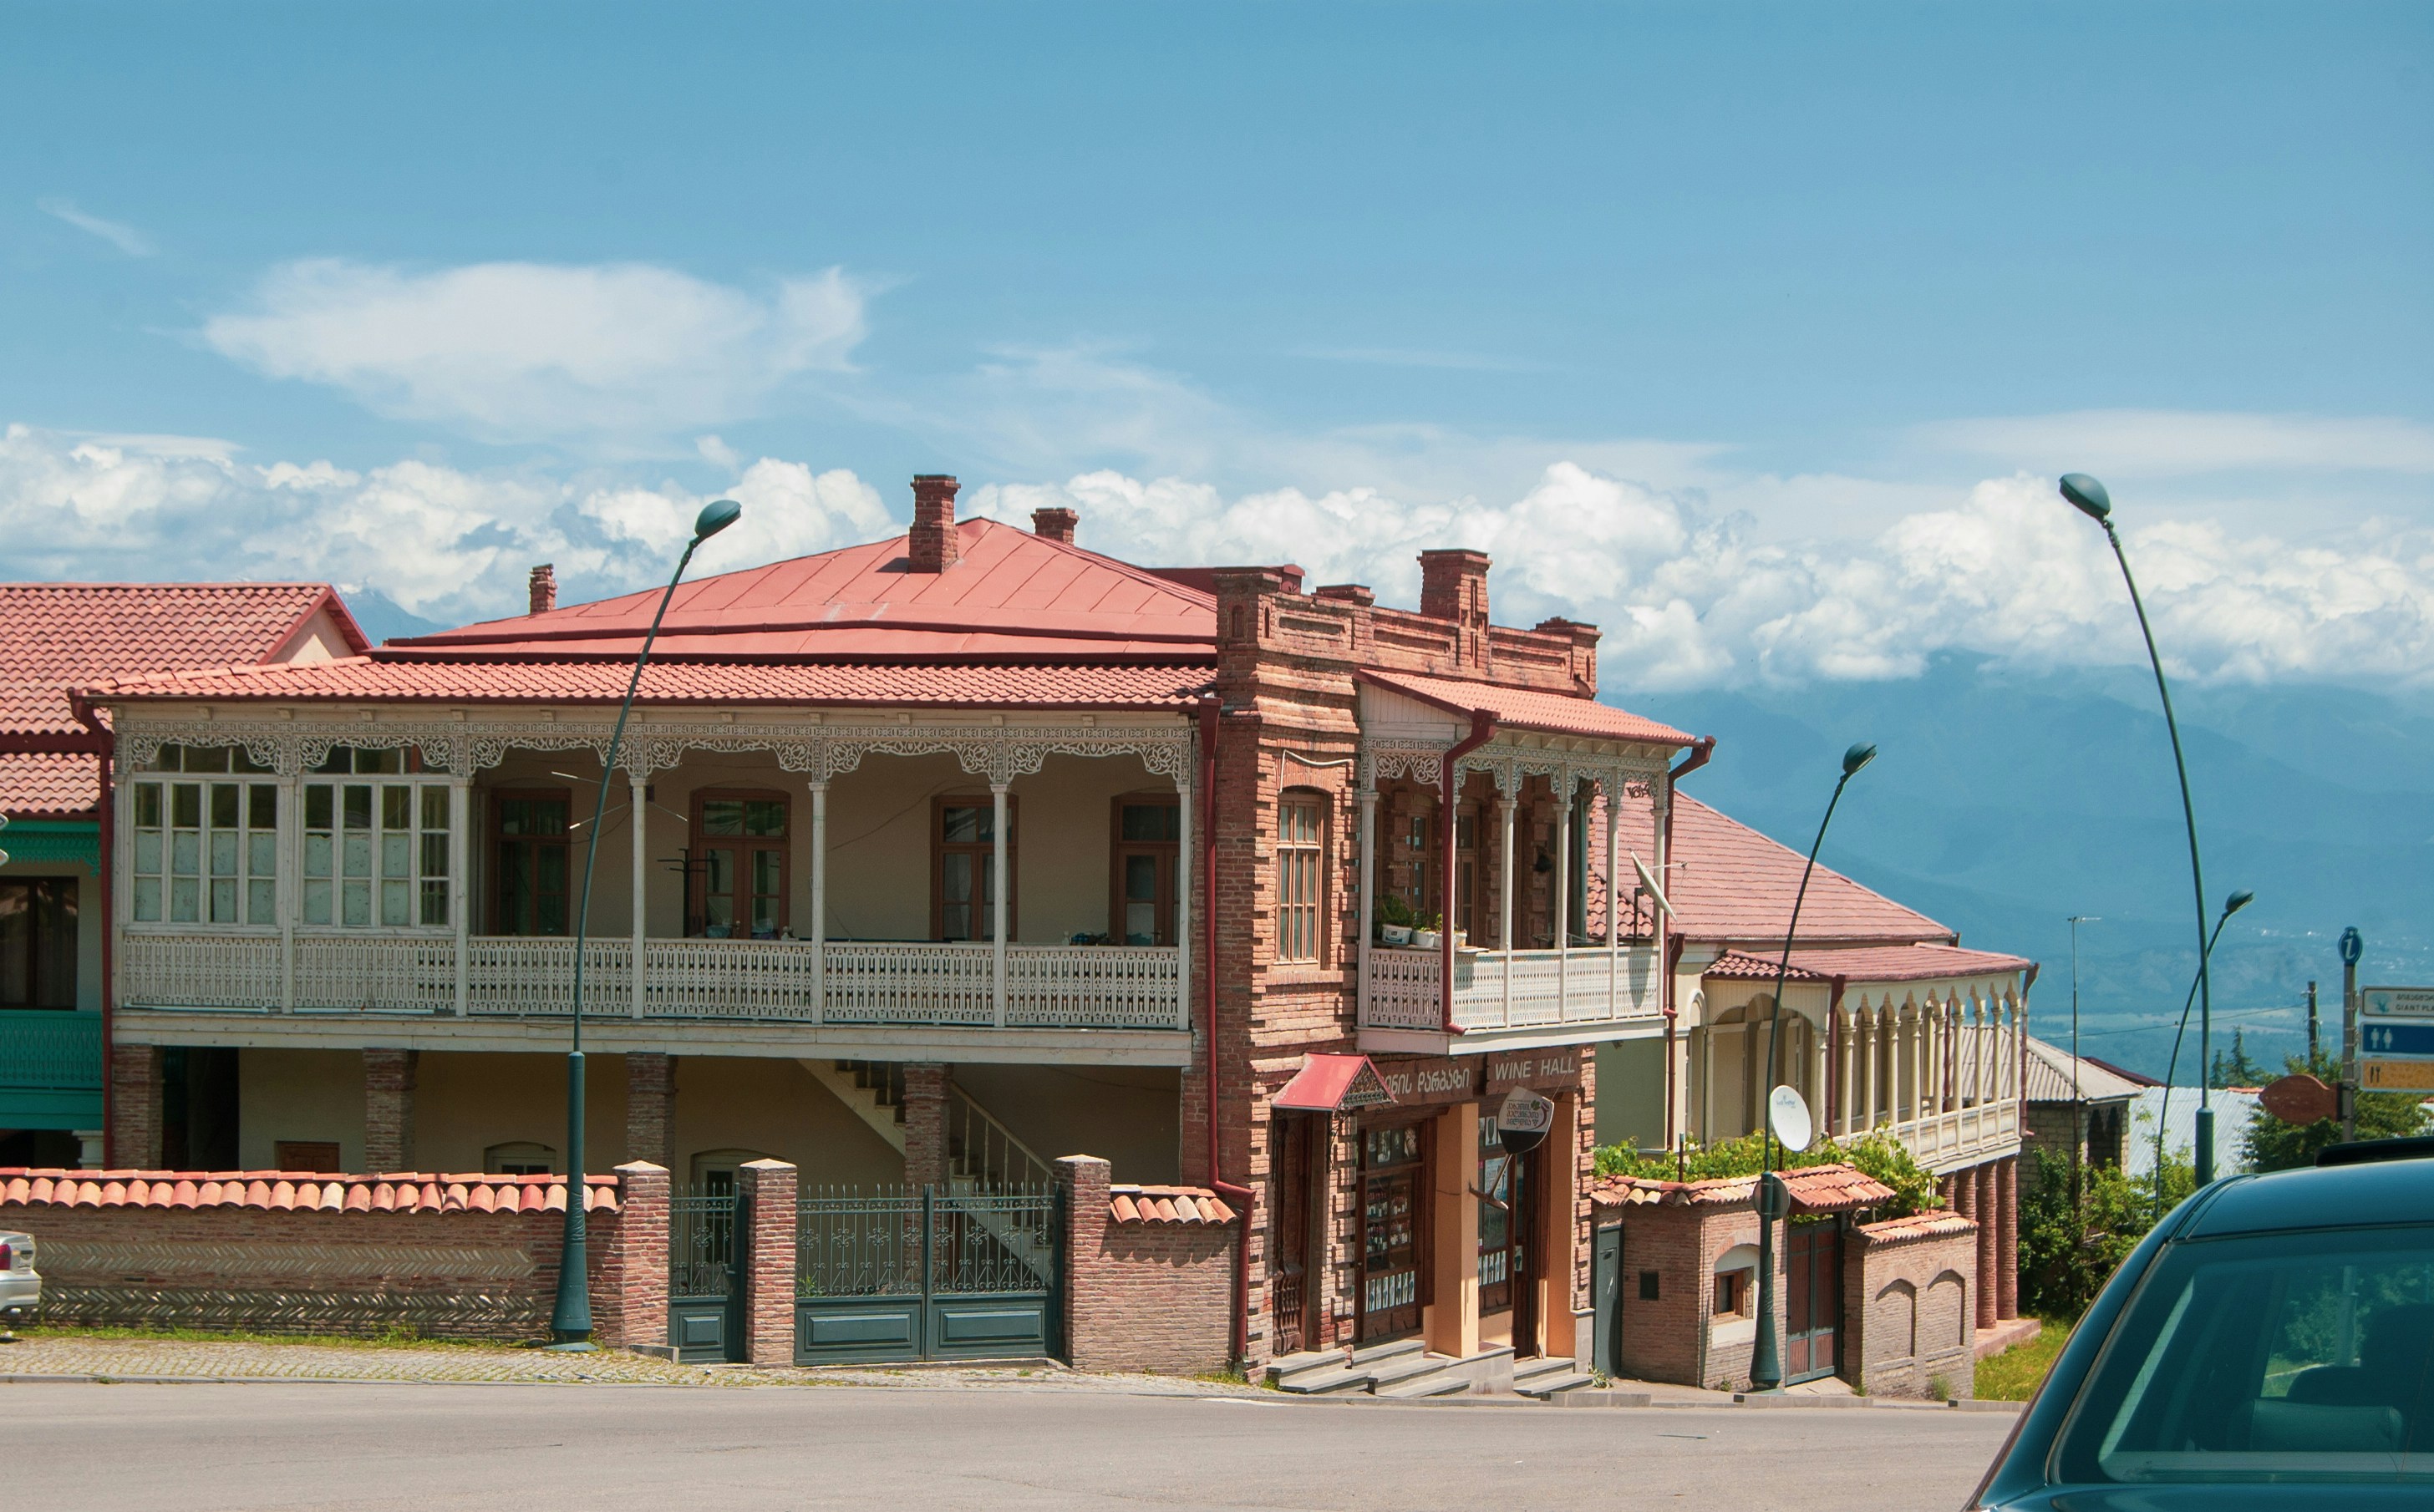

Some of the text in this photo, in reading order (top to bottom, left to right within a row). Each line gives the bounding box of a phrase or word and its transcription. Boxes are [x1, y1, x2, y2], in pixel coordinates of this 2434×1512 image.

[1417, 1068, 1470, 1093] დარბაზი
[1495, 1057, 1575, 1081] WINE HALL
